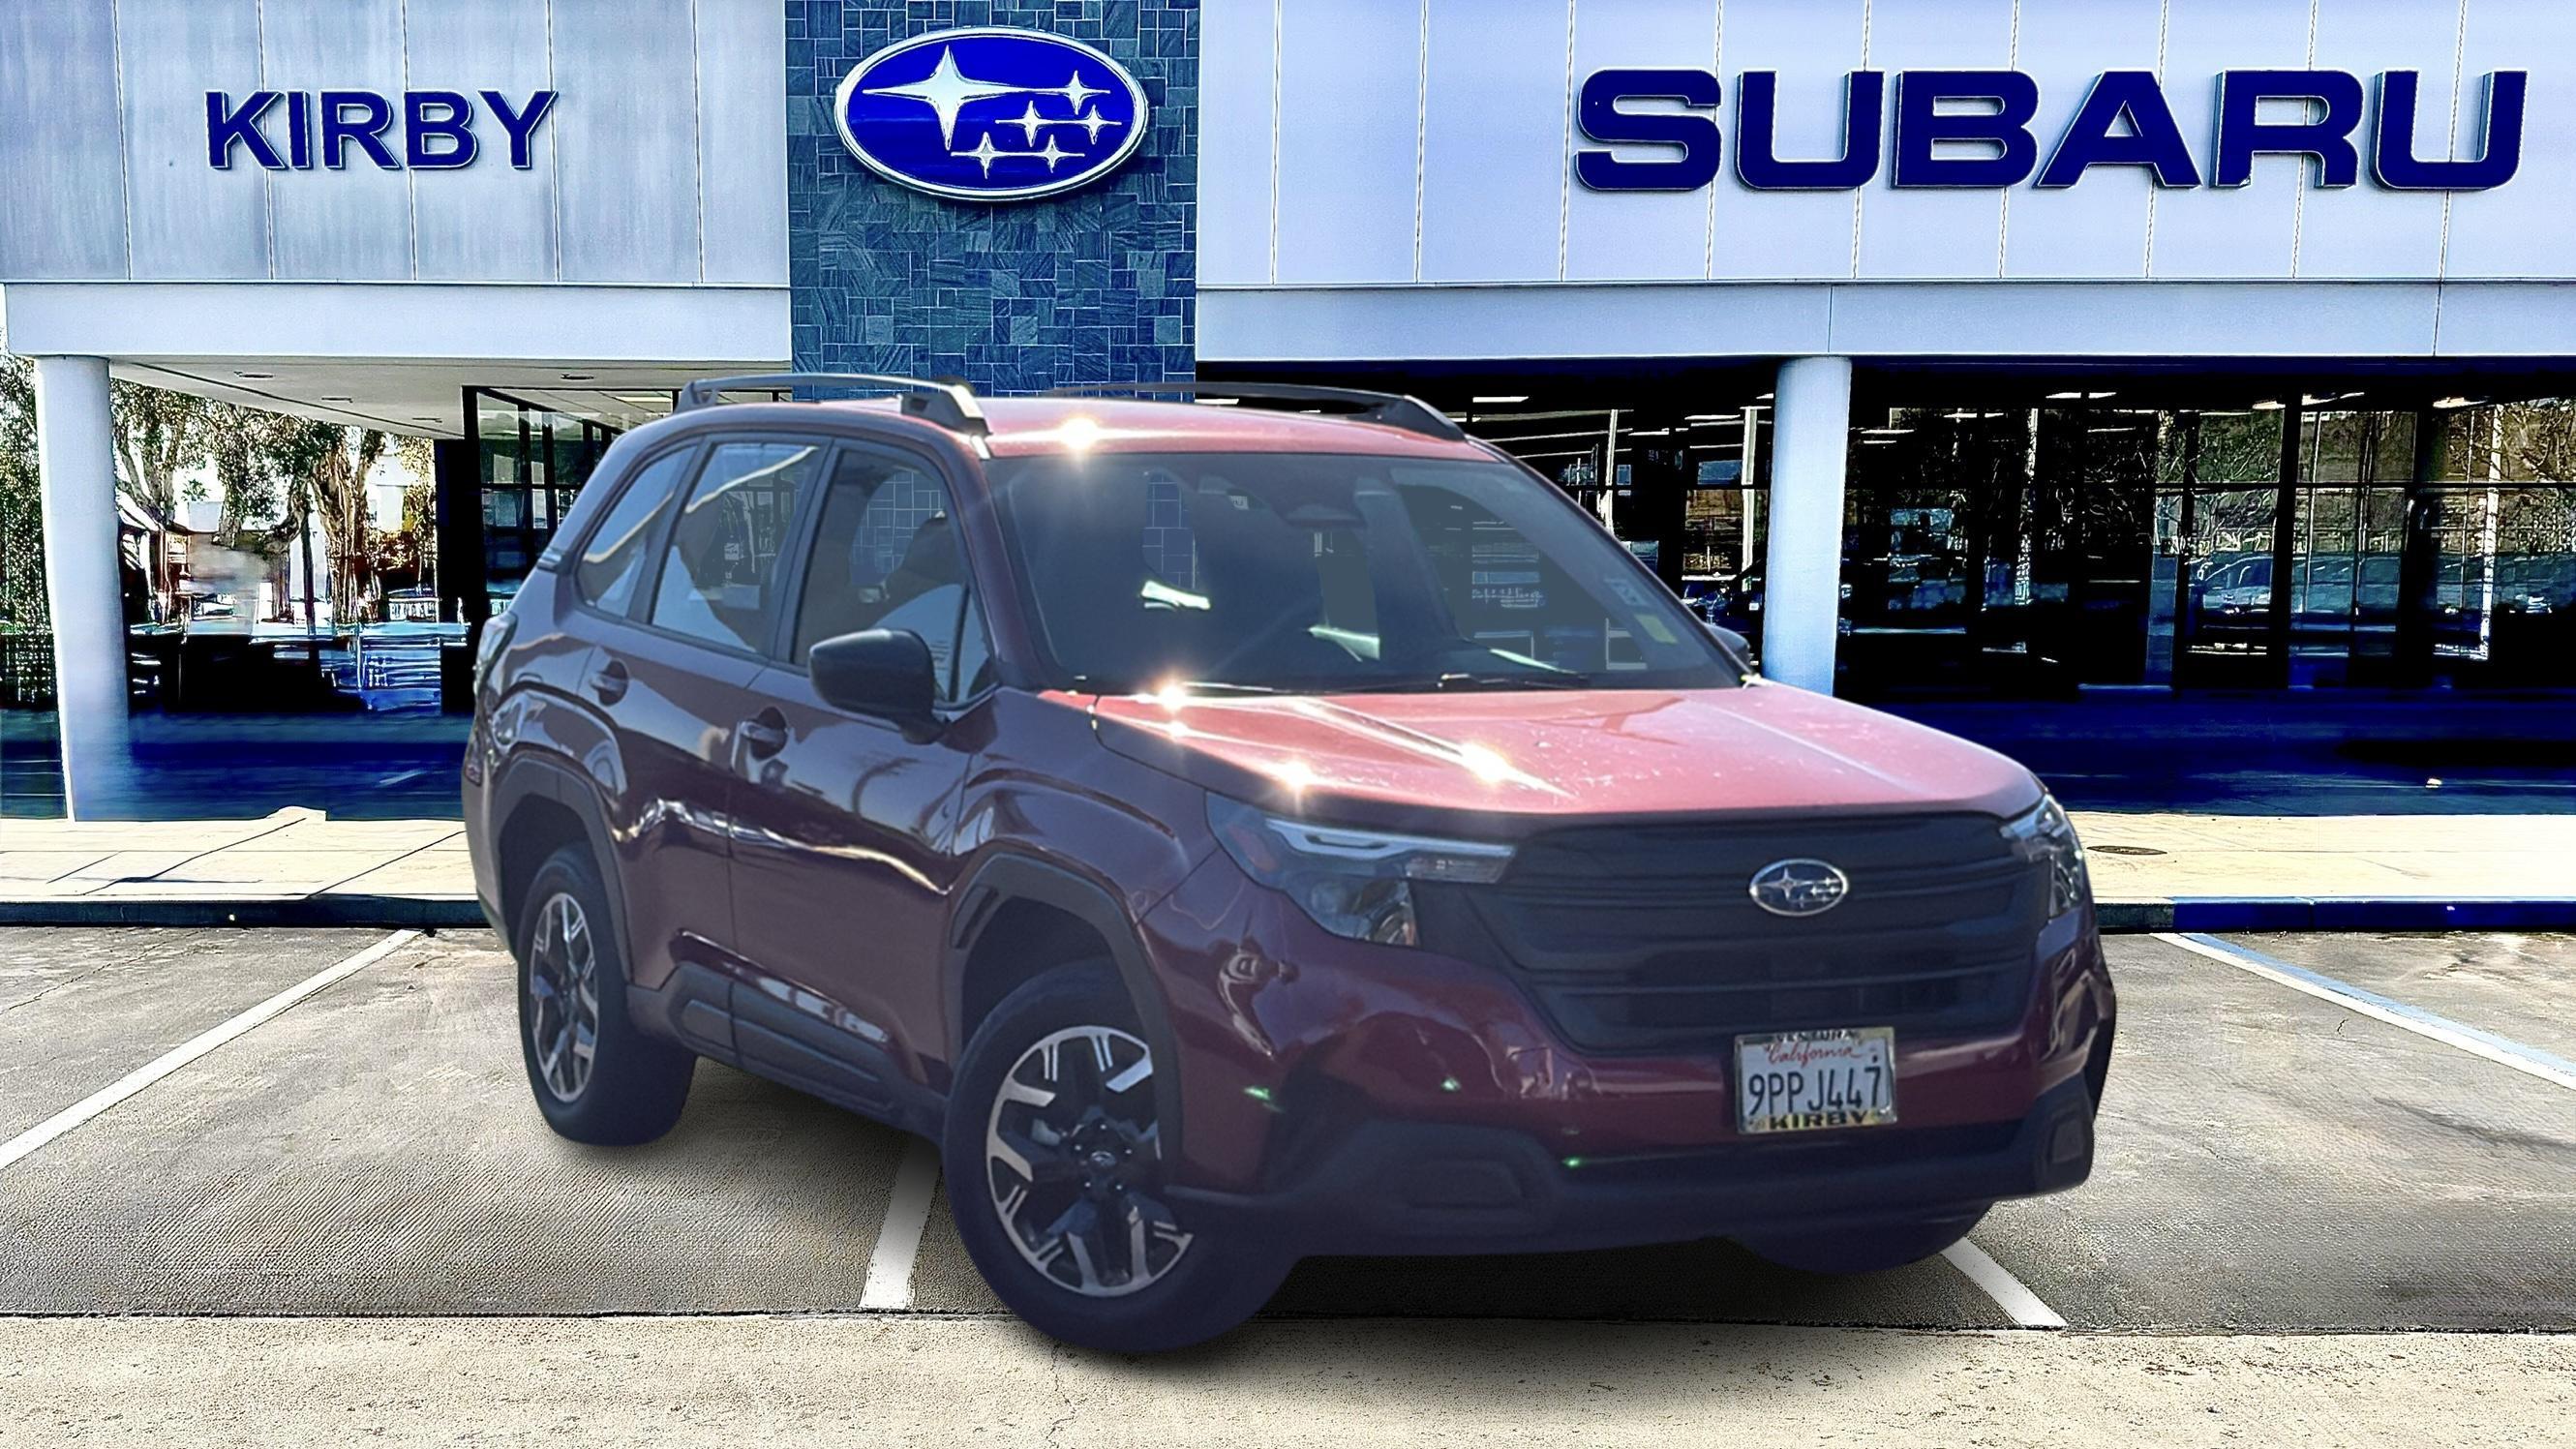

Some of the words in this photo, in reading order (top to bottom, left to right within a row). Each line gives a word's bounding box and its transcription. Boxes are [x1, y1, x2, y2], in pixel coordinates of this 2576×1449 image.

[205, 90, 558, 170] KIRBY
[1575, 69, 2526, 191] SUBARU
[1767, 1041, 1862, 1069] California
[1748, 1067, 1880, 1116] 9PPJ447
[1770, 1110, 1867, 1131] KIRBY
